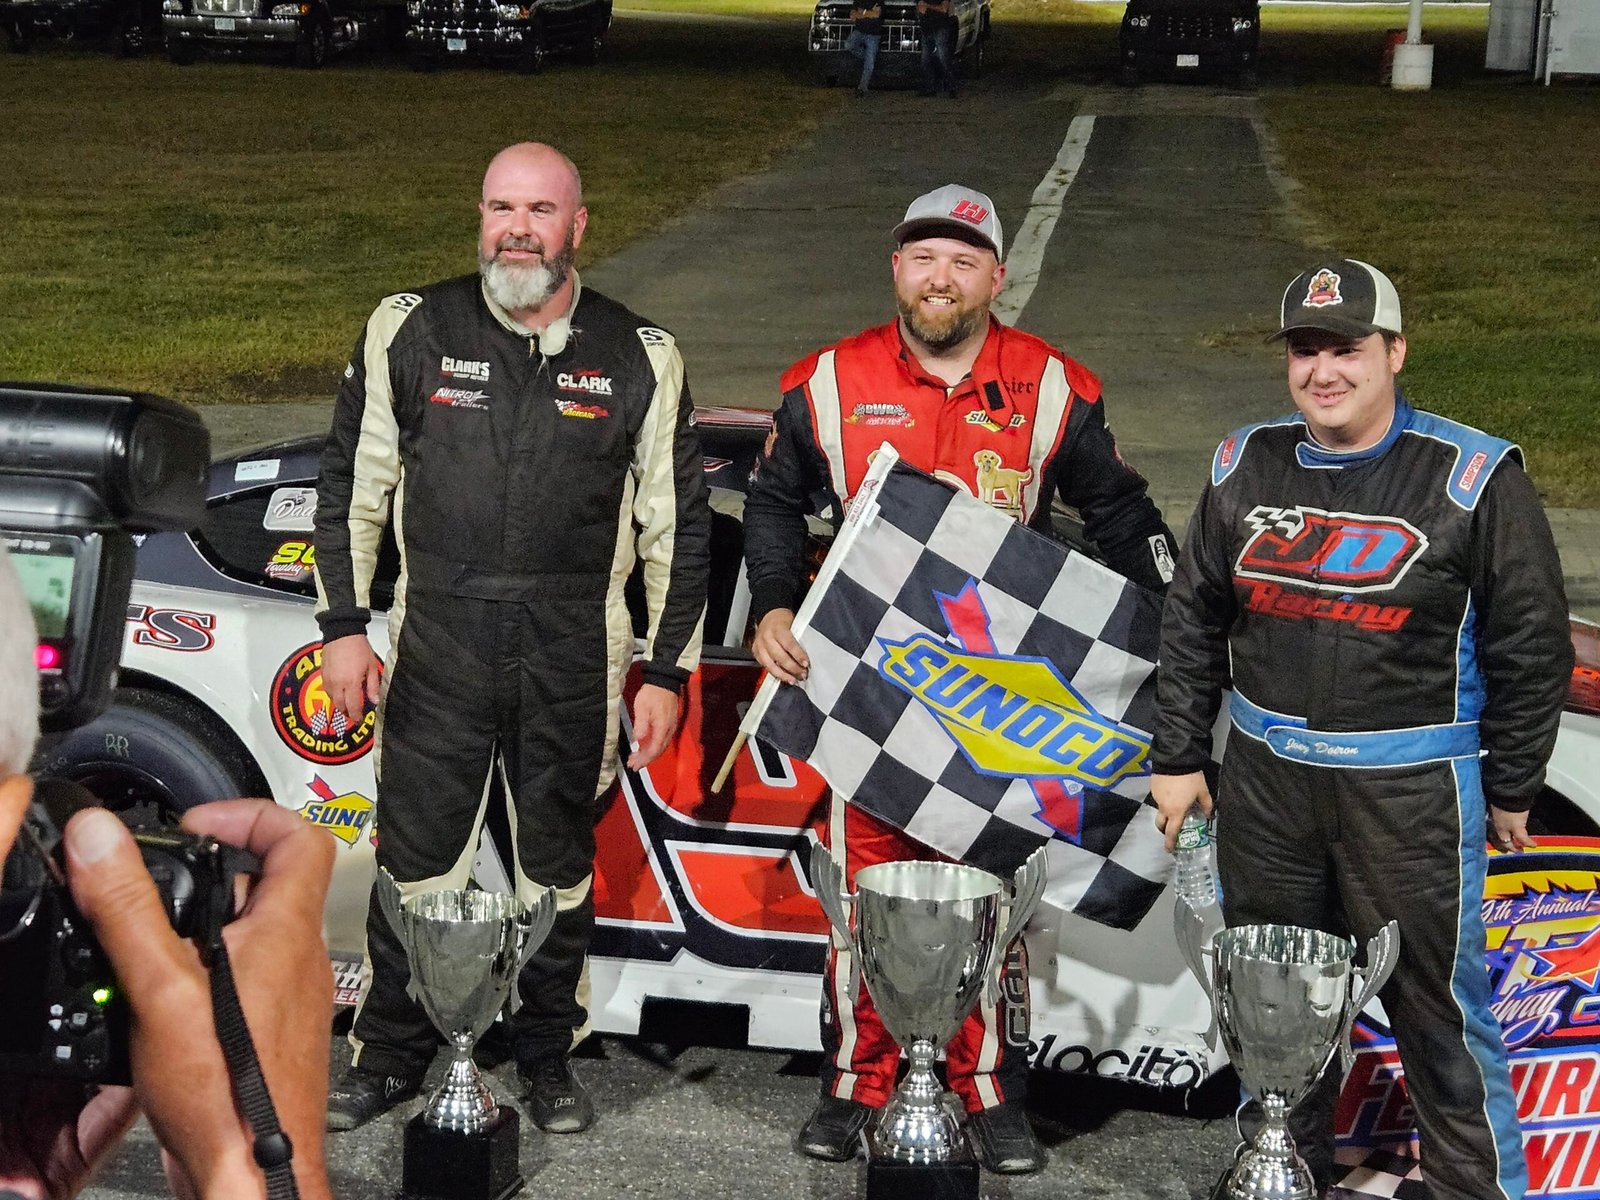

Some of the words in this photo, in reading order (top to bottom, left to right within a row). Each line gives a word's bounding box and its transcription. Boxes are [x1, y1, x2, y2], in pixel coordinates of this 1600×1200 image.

[435, 387, 474, 400] NITRO
[556, 372, 613, 392] CLARK
[1461, 453, 1485, 489] SIMPSON
[1232, 576, 1413, 633] Racing
[125, 605, 215, 652] S
[282, 701, 349, 753] TRADING
[350, 709, 376, 745] LTD
[889, 643, 1144, 780] SUNOCO
[1284, 737, 1310, 753] Joey
[1511, 890, 1597, 925] Annual
